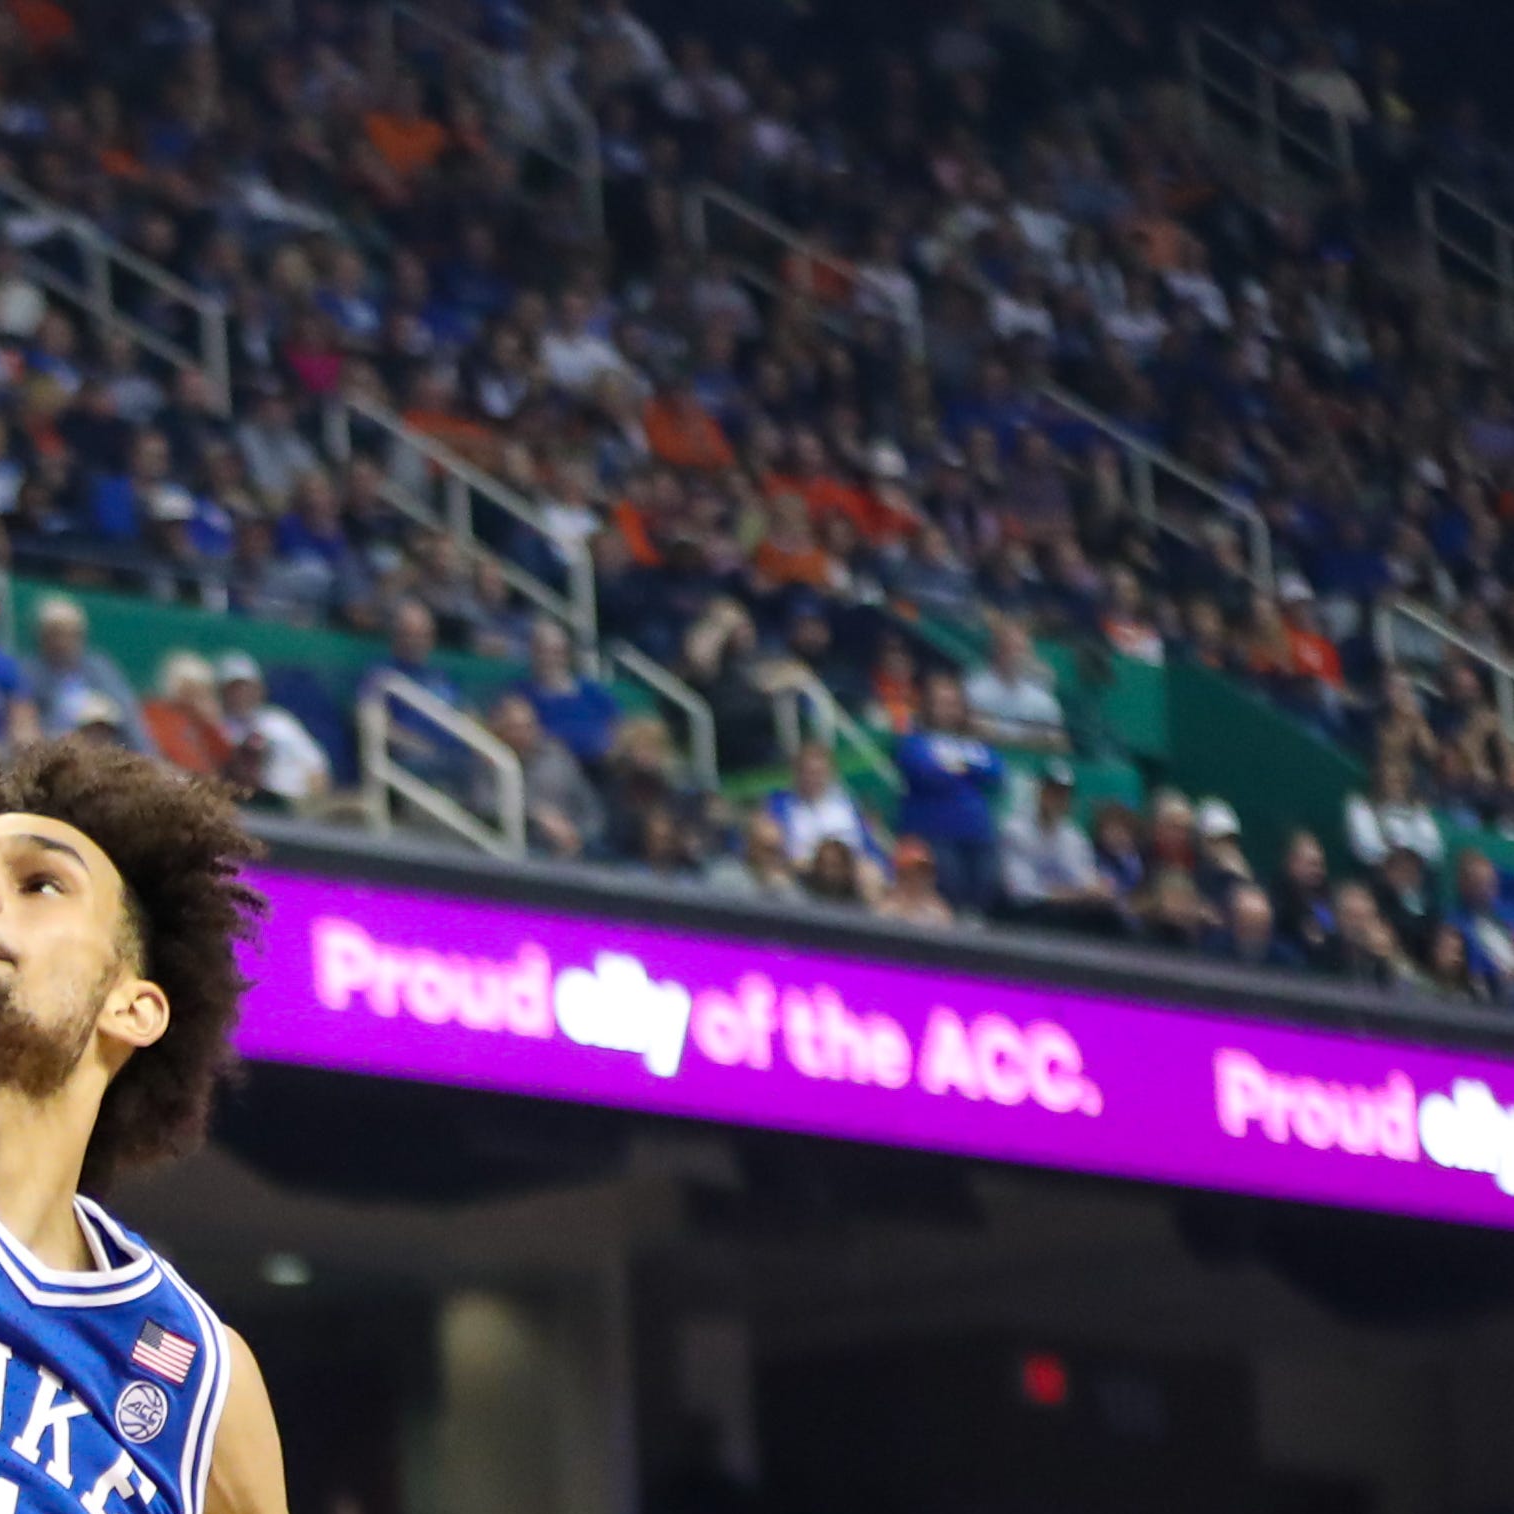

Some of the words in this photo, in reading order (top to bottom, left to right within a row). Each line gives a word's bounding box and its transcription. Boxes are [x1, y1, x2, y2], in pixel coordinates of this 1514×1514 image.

[310, 917, 554, 1039] Proud
[690, 973, 776, 1069] of
[781, 984, 912, 1089] the
[917, 1008, 1104, 1117] ACC.
[1212, 1047, 1420, 1163] Proud
